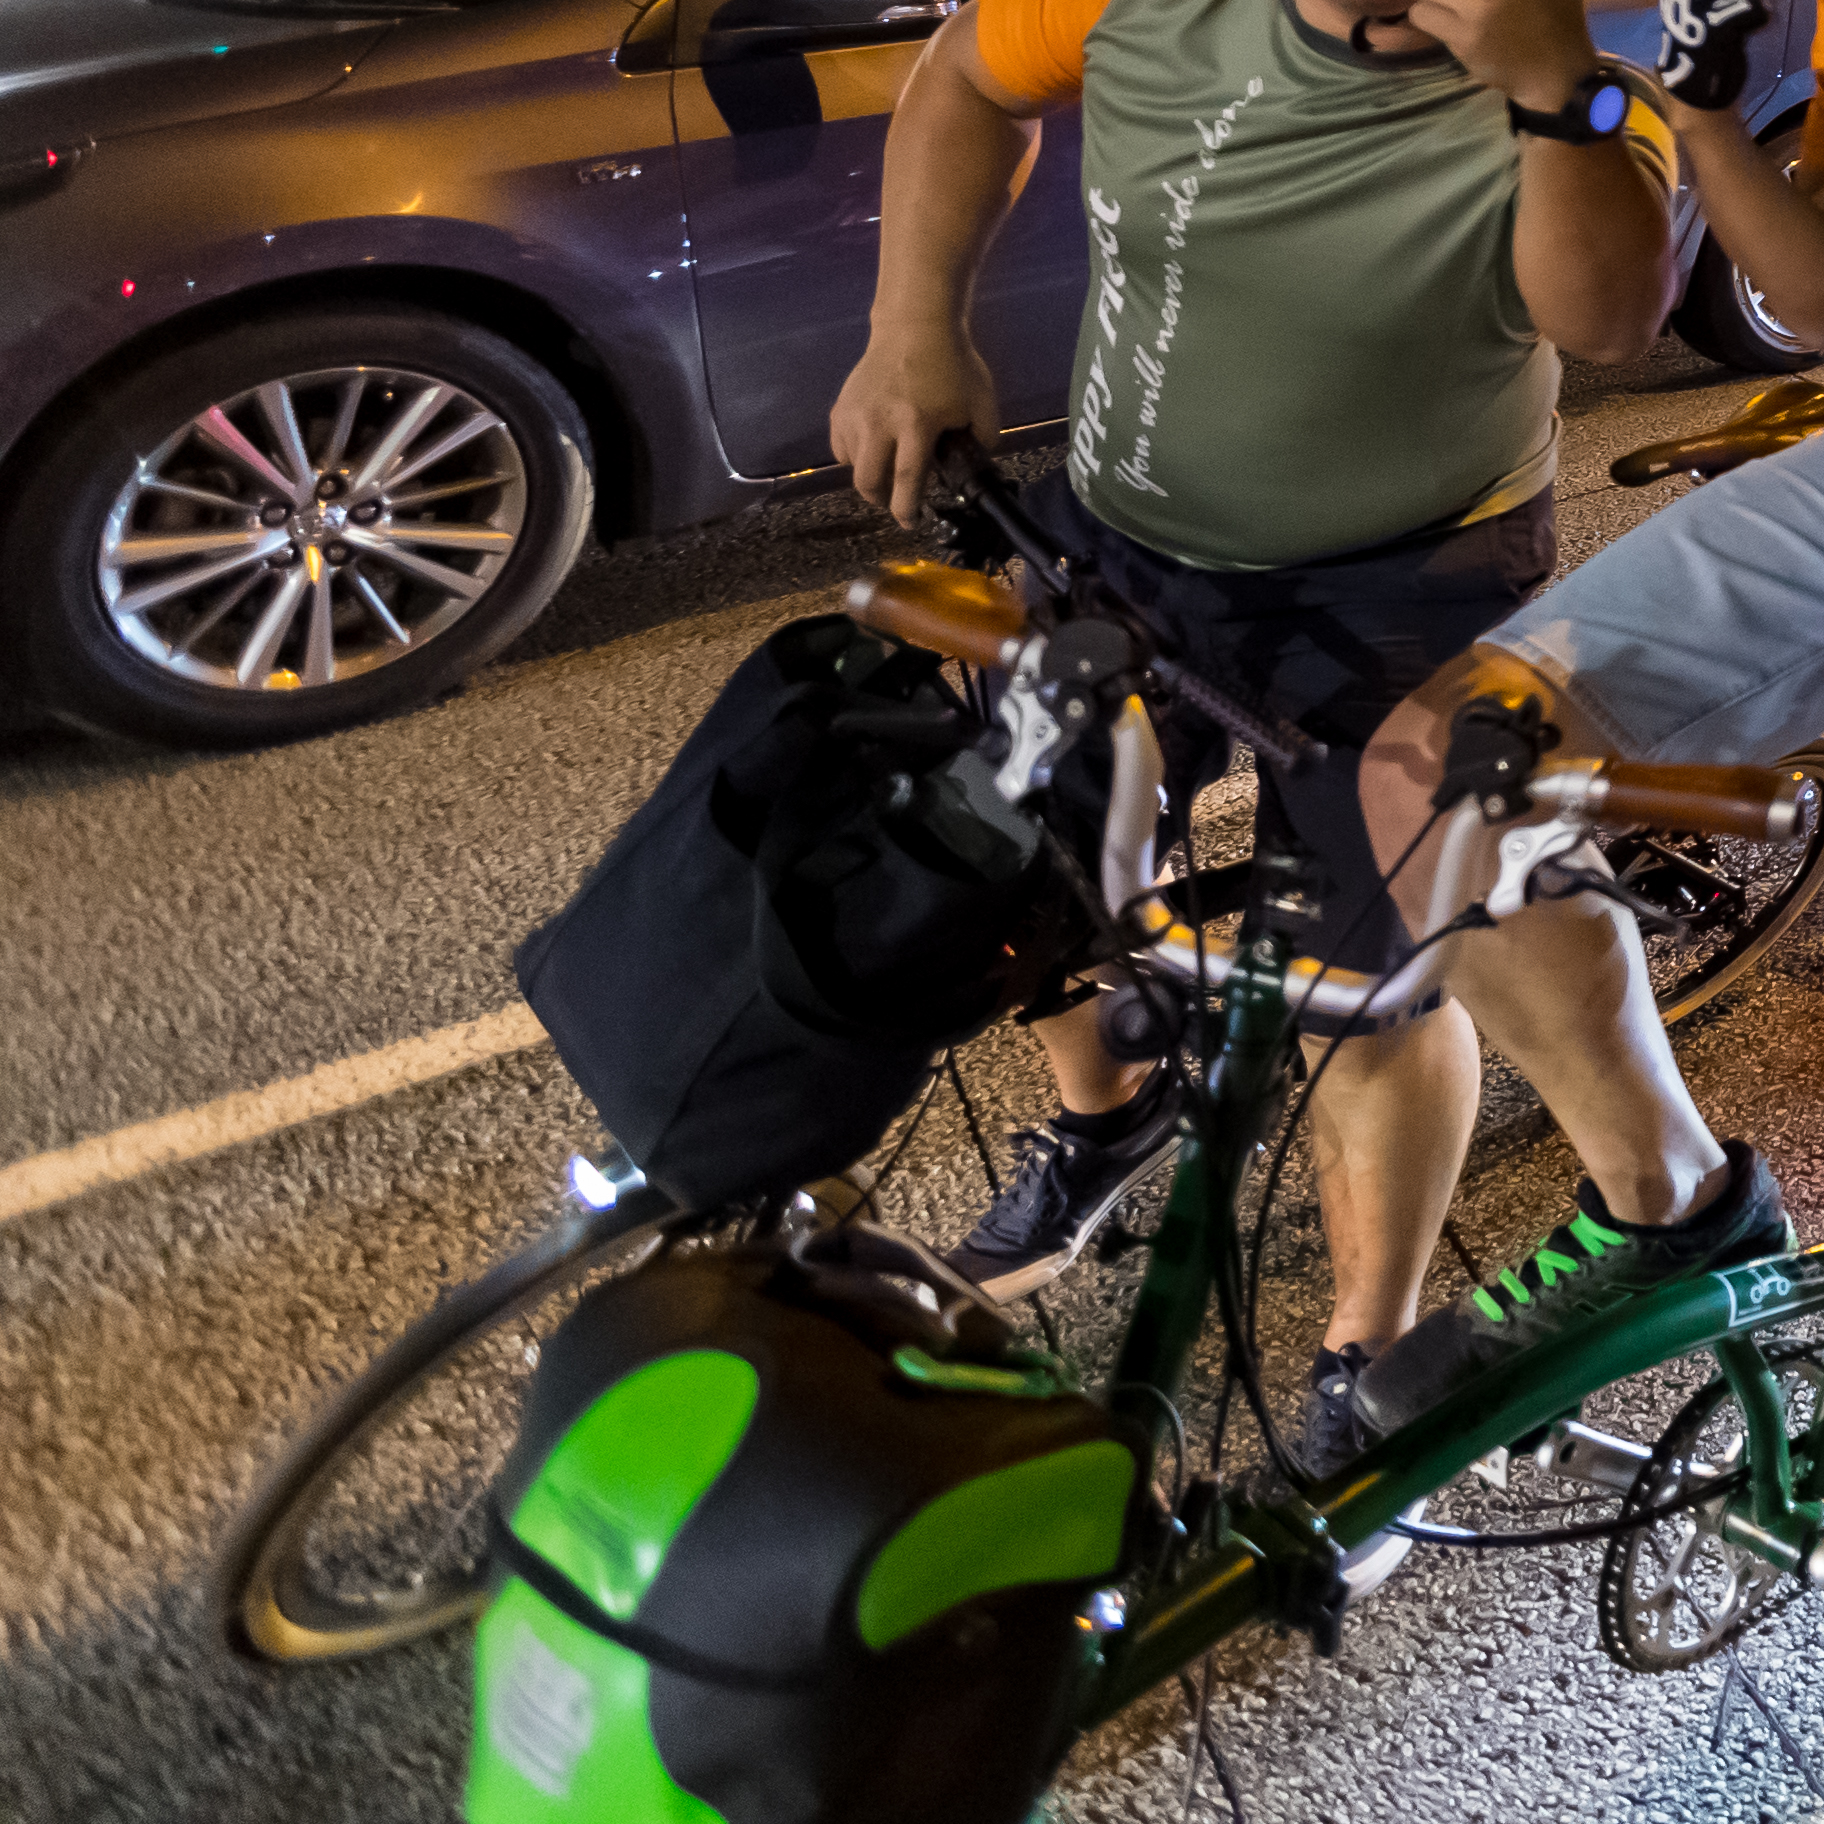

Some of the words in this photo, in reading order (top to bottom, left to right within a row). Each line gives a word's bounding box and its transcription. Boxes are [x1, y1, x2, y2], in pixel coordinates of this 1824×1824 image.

[1160, 175, 1199, 251] ride
[1089, 187, 1126, 348] Fleet
[1156, 259, 1184, 353] never
[1132, 343, 1166, 427] will
[1114, 434, 1170, 498] You
